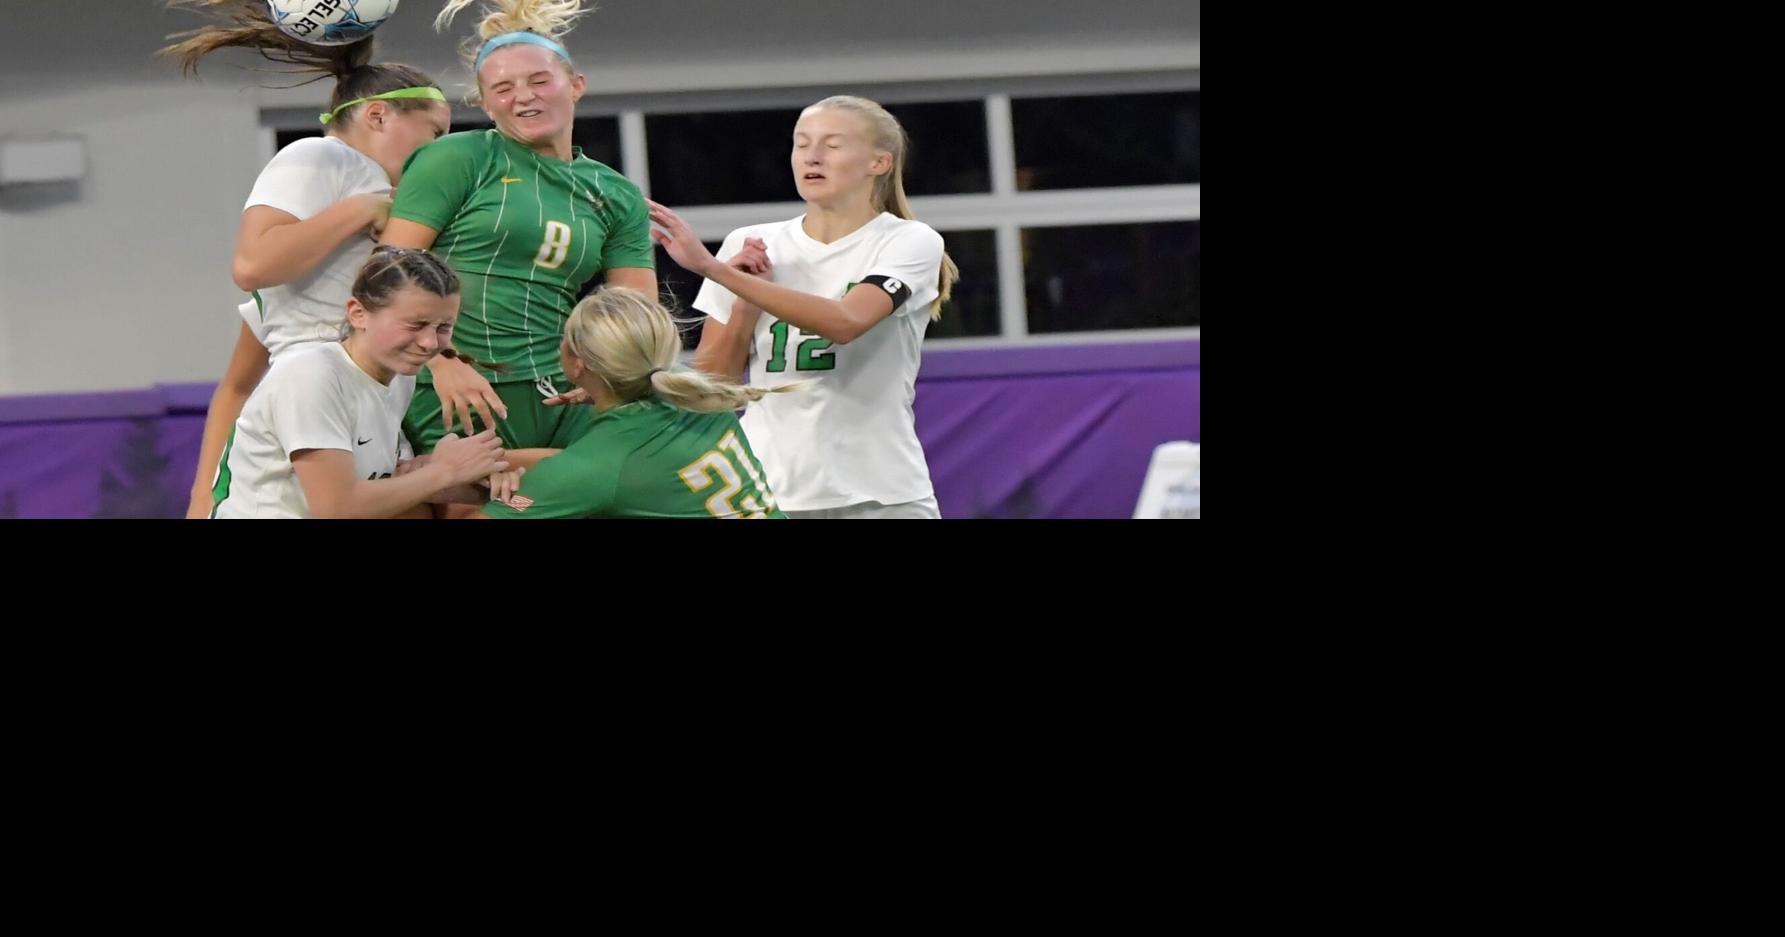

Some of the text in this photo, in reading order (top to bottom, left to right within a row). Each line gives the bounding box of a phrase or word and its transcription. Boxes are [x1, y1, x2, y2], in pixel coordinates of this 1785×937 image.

[534, 220, 571, 269] 8
[882, 277, 902, 294] C
[766, 320, 836, 373] 12
